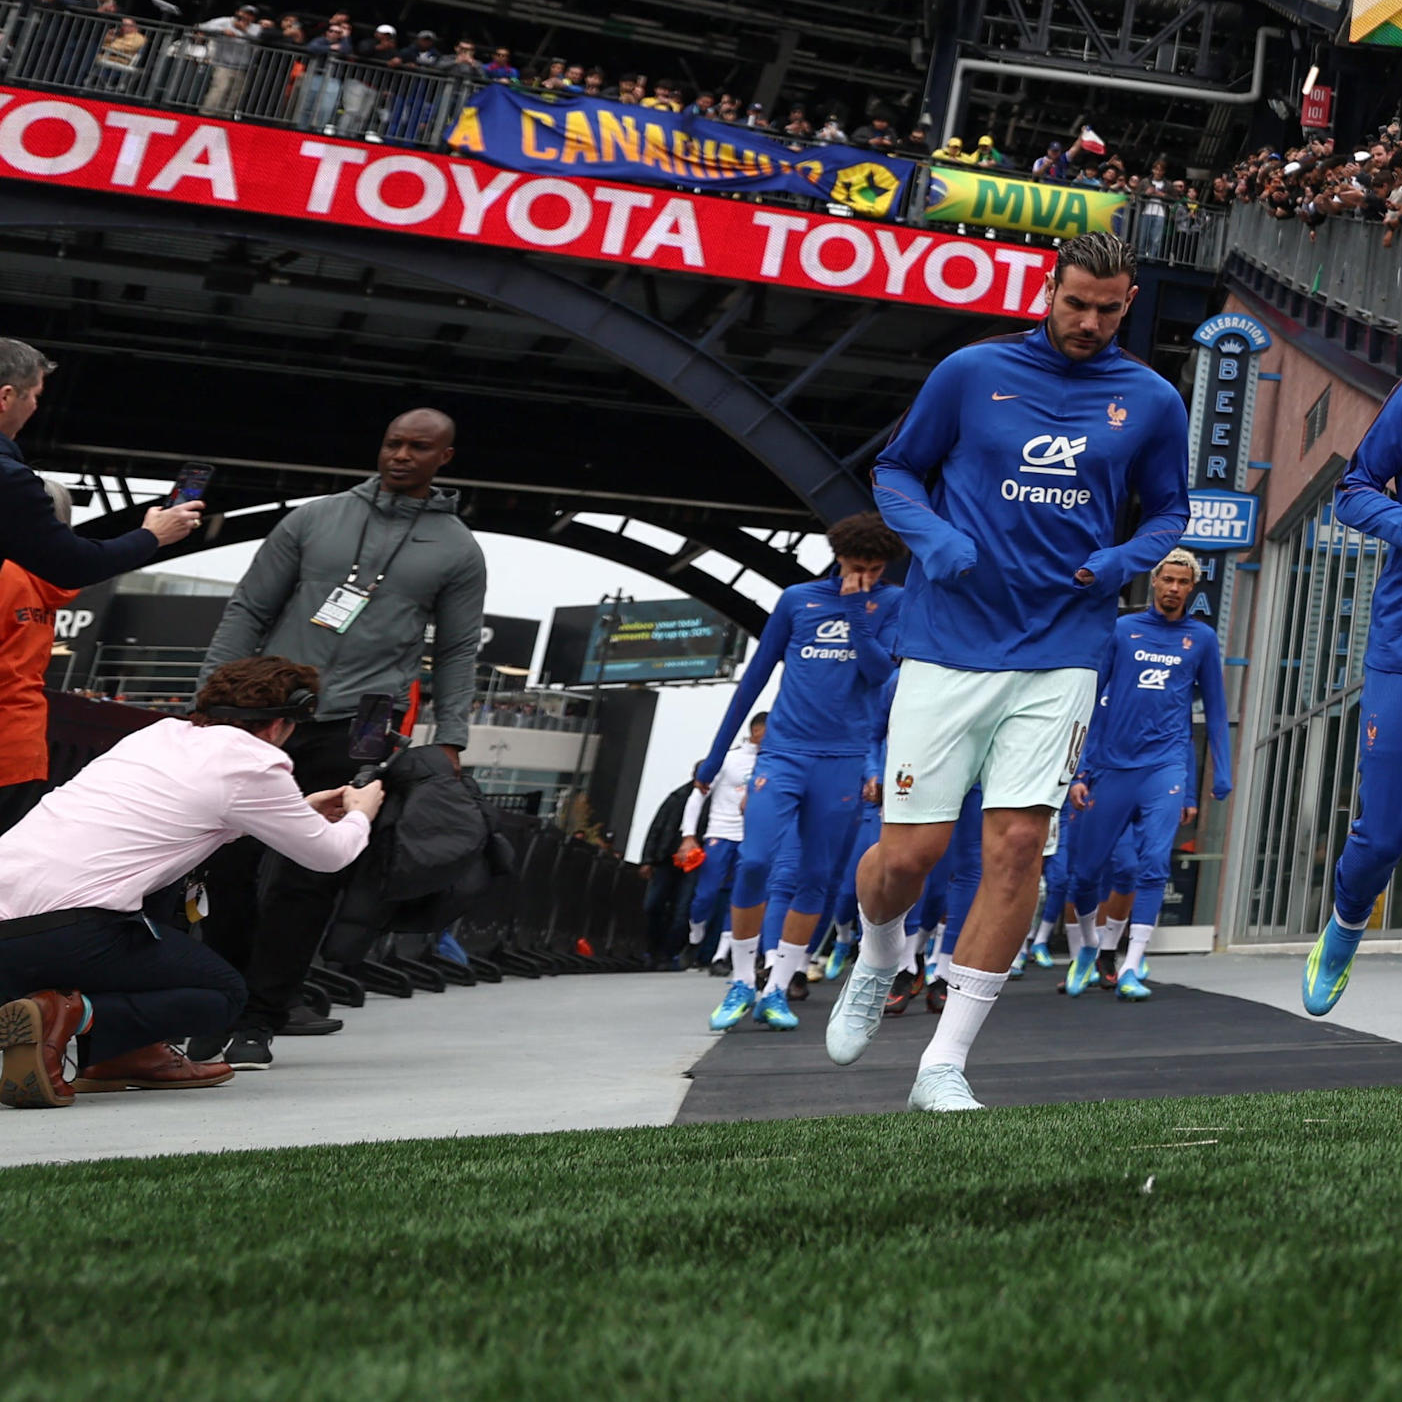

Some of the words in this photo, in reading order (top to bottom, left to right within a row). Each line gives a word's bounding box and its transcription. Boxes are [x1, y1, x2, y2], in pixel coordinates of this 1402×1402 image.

[0, 94, 239, 202] OTA
[300, 140, 705, 269] TOYOTA
[972, 179, 1088, 235] MVA
[1199, 316, 1266, 346] CELEBRATION
[1206, 358, 1239, 479] BEER
[1000, 478, 1091, 509] Orange
[1189, 501, 1238, 520] BUD
[800, 645, 857, 662] Orange
[1134, 650, 1182, 666] Orange
